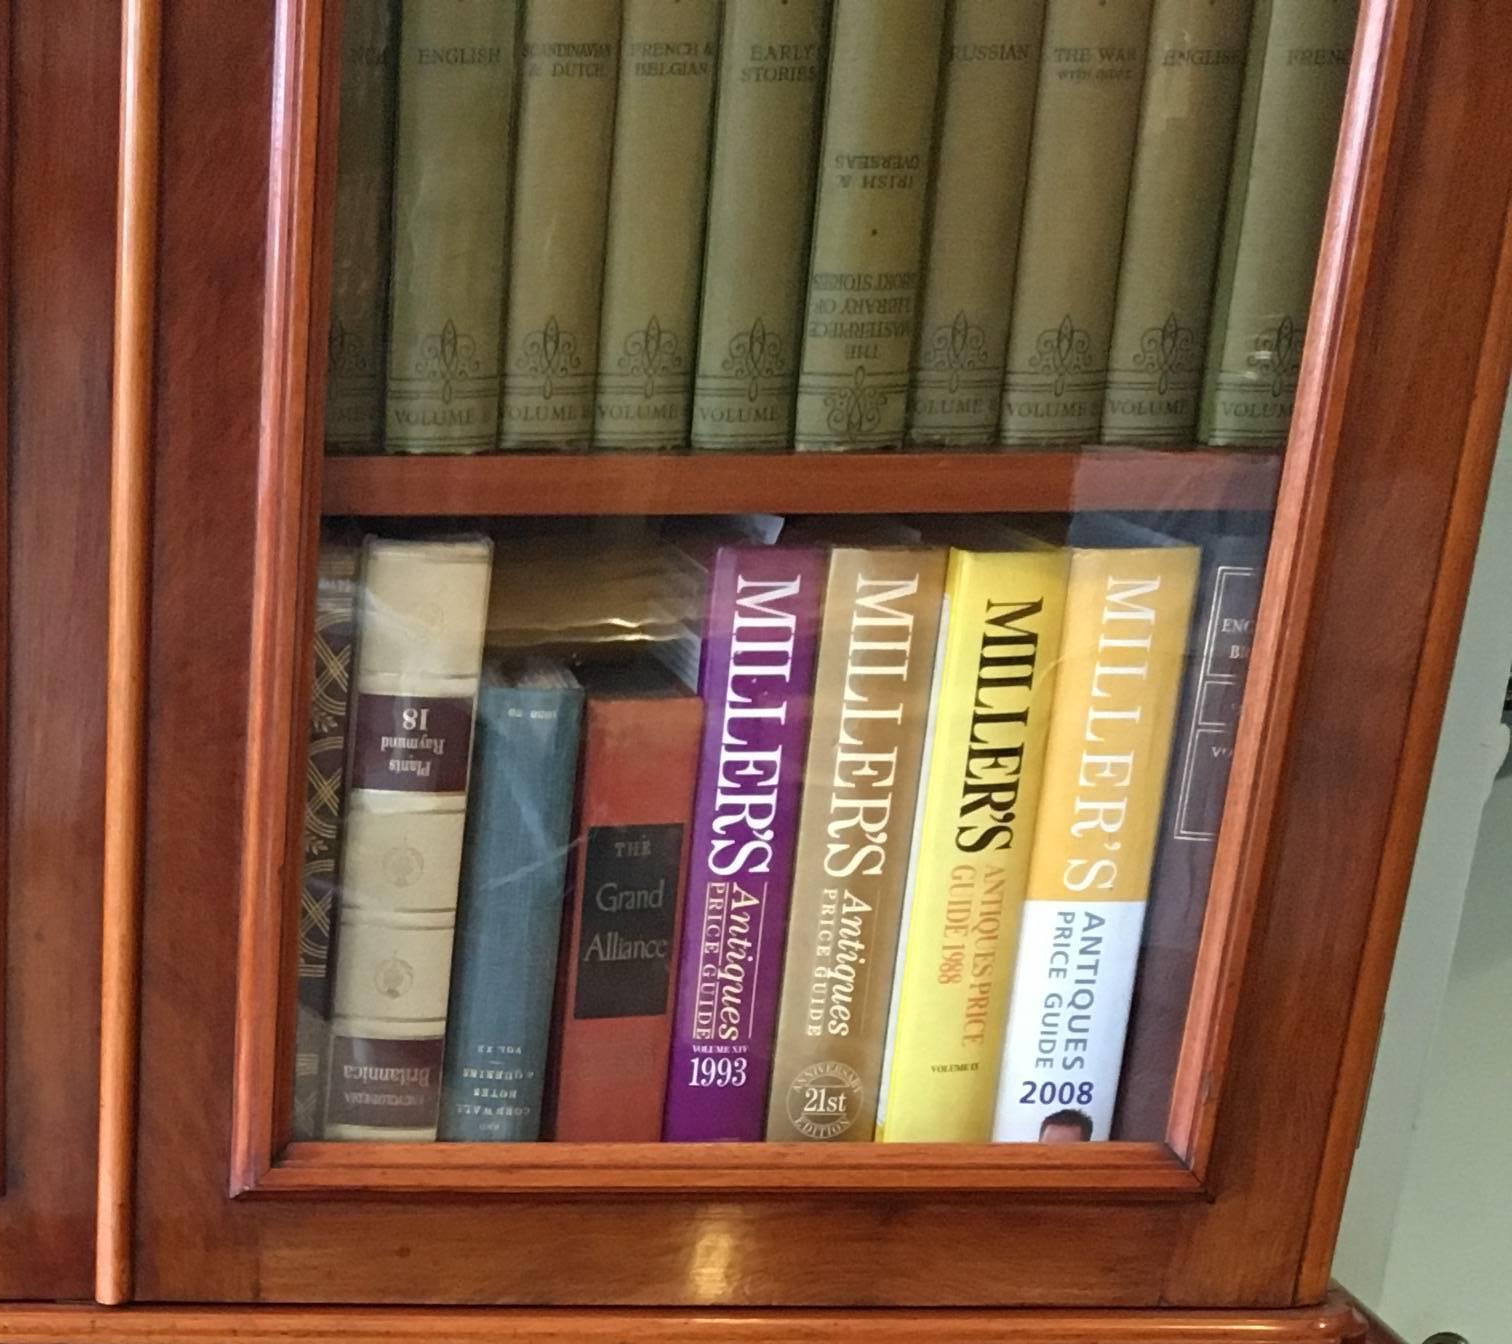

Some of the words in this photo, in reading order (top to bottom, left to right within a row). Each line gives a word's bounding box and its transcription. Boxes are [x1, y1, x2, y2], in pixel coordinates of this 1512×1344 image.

[417, 47, 503, 65] ENGLISH
[629, 43, 698, 57] FRENCH
[750, 44, 814, 62] EARLY
[951, 44, 1033, 62] RUSSIAN
[1054, 48, 1090, 64] THE
[1098, 48, 1138, 63] WAR
[740, 65, 818, 82] STORIES
[834, 154, 921, 171] OVERSEAS
[861, 174, 914, 190] IRISH
[841, 297, 913, 316] LIBRARY
[402, 707, 430, 731] 18
[708, 574, 801, 876] MILLER'S
[823, 573, 920, 878] MILLER'S
[955, 597, 1044, 853] MILLER'S
[380, 733, 446, 756] Raymund
[1063, 576, 1162, 893] MILLER'S
[389, 758, 432, 777] Plants
[614, 840, 652, 857] THE
[595, 878, 666, 912] Grand
[943, 864, 976, 938] GUIDE
[704, 882, 726, 954] PRICE
[815, 887, 838, 957] PRICE
[971, 863, 1006, 979] ANTIQUES
[583, 930, 668, 962] Alliance
[1048, 911, 1076, 980] PRICE
[718, 881, 760, 1042] Antiques
[827, 888, 872, 1038] Antiques
[937, 943, 966, 985] 1988
[696, 963, 718, 1040] GUIDE
[806, 966, 828, 1038] GUIDE
[1061, 911, 1106, 1071] ANTIQUES
[961, 981, 993, 1047] PRICE
[1035, 992, 1064, 1070] GUIDE
[692, 1044, 731, 1054] VOLUME
[343, 1064, 431, 1088] Britannica
[462, 1067, 524, 1081] QUERIES
[689, 1056, 748, 1088] 1993
[791, 1061, 865, 1095] ANNIVERSARY
[930, 1063, 968, 1073] VOLUME
[473, 1087, 518, 1099] NOTES
[803, 1086, 848, 1113] 21st
[1019, 1080, 1094, 1106] 2008
[455, 1103, 531, 1117] CORNWALL
[793, 1113, 851, 1139] EDITION
